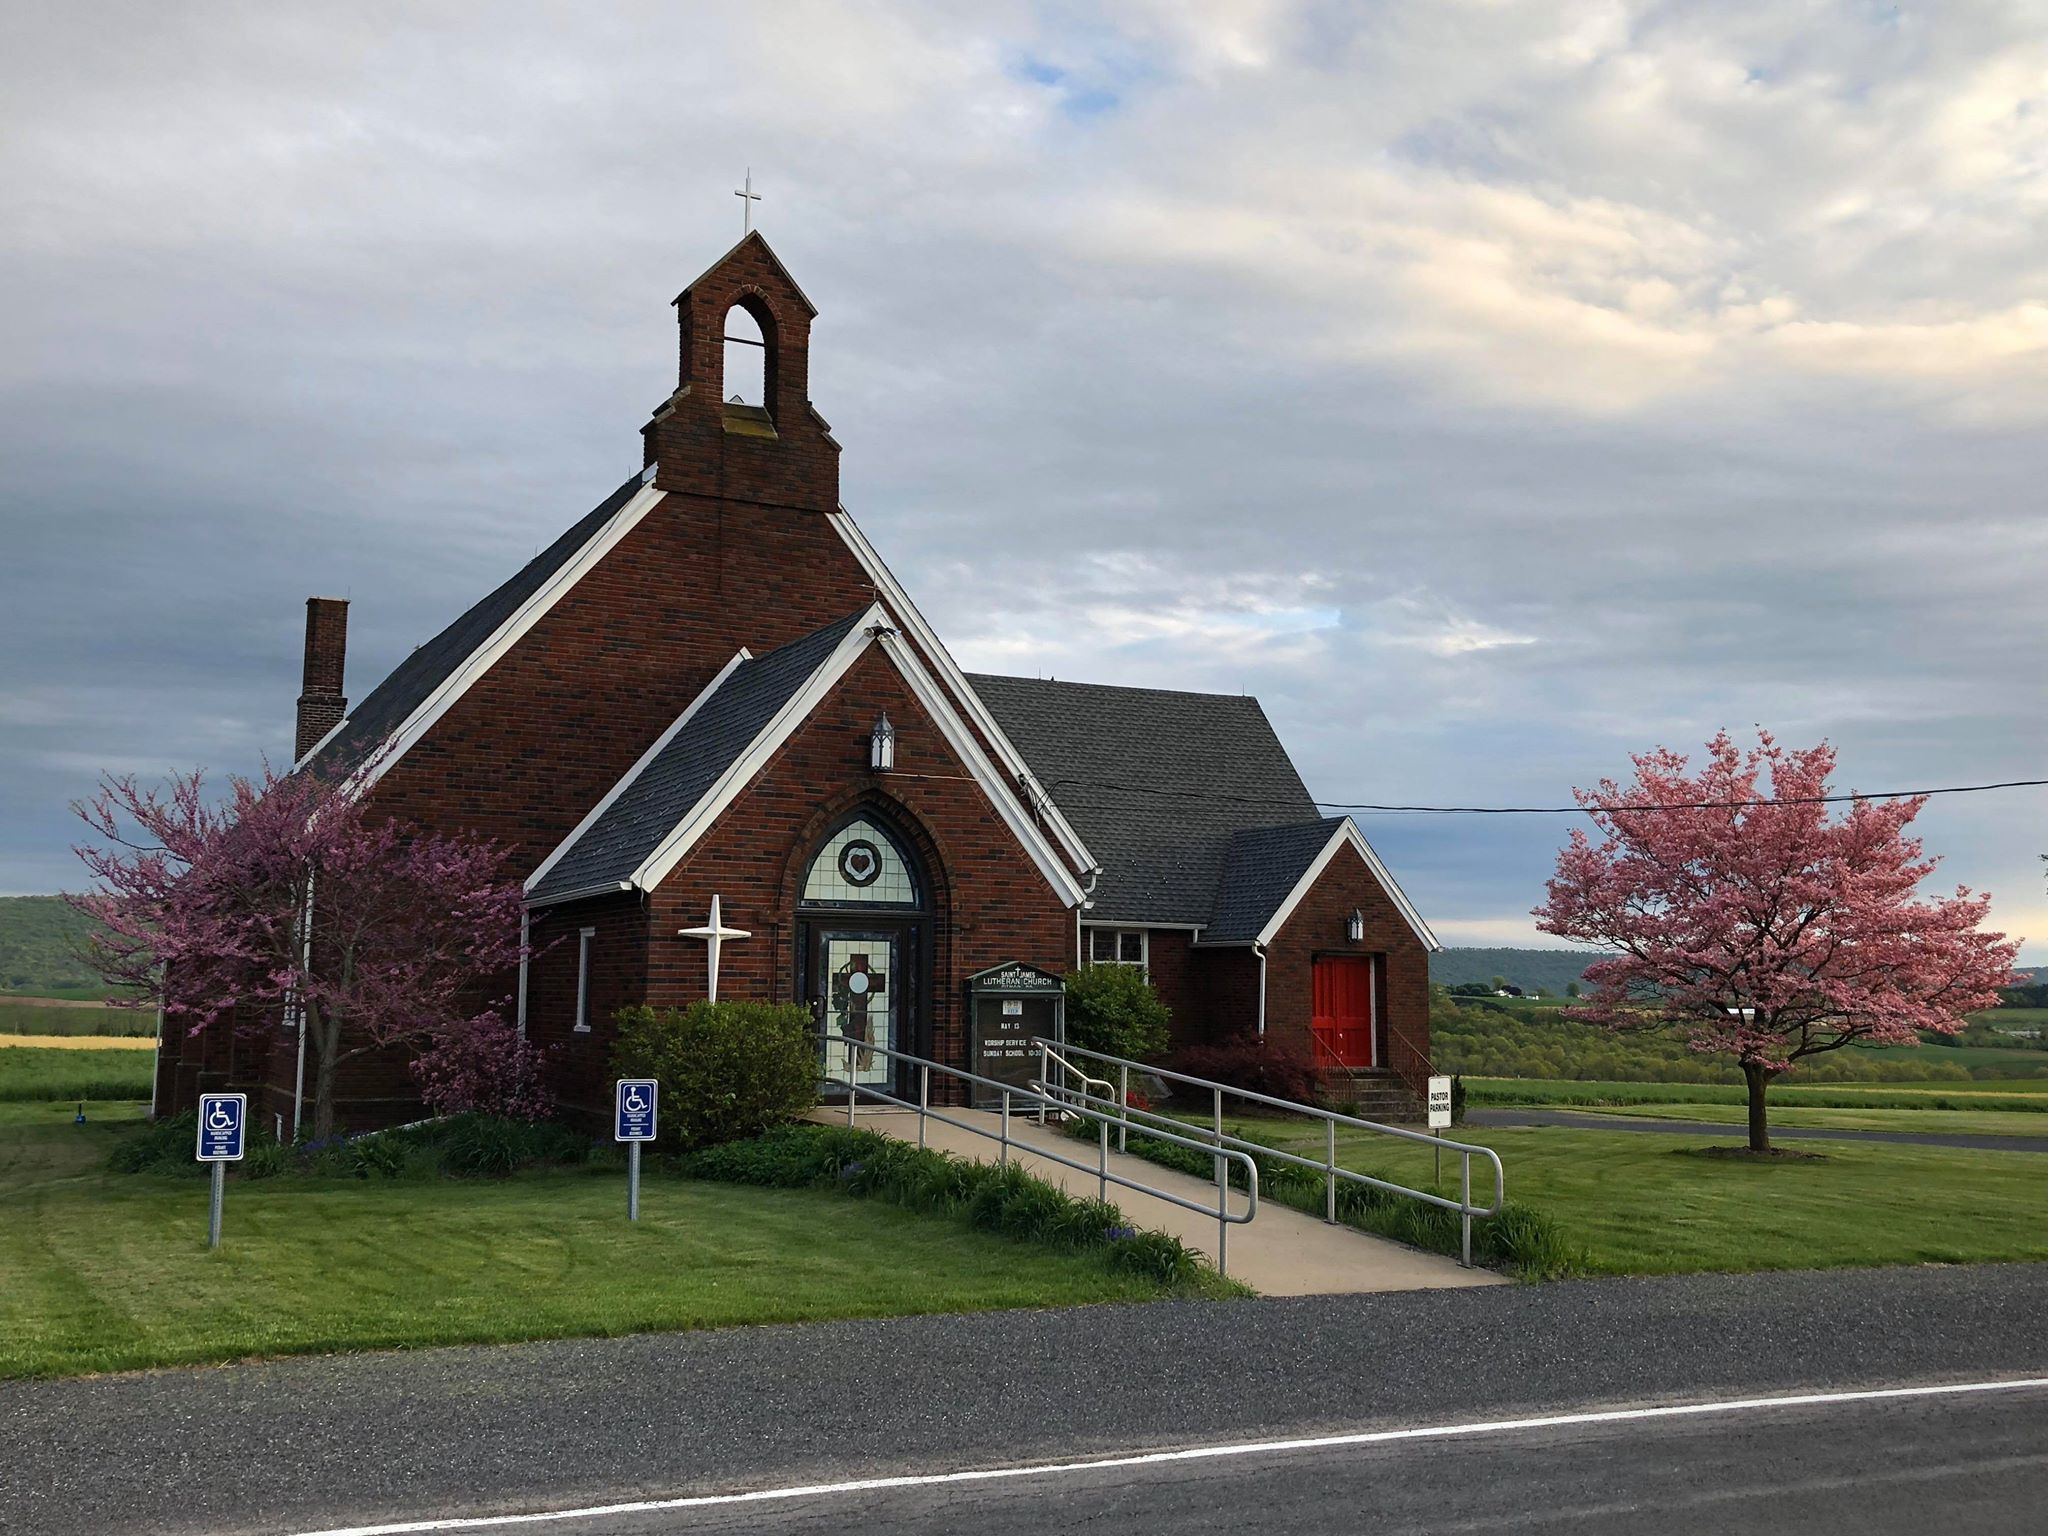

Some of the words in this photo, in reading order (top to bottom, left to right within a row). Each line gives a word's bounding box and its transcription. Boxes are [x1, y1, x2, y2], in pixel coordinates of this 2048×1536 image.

[983, 977, 1021, 985] LUTHERAN
[1431, 1091, 1449, 1101] PASTOR
[1430, 1103, 1450, 1112] PARKING
